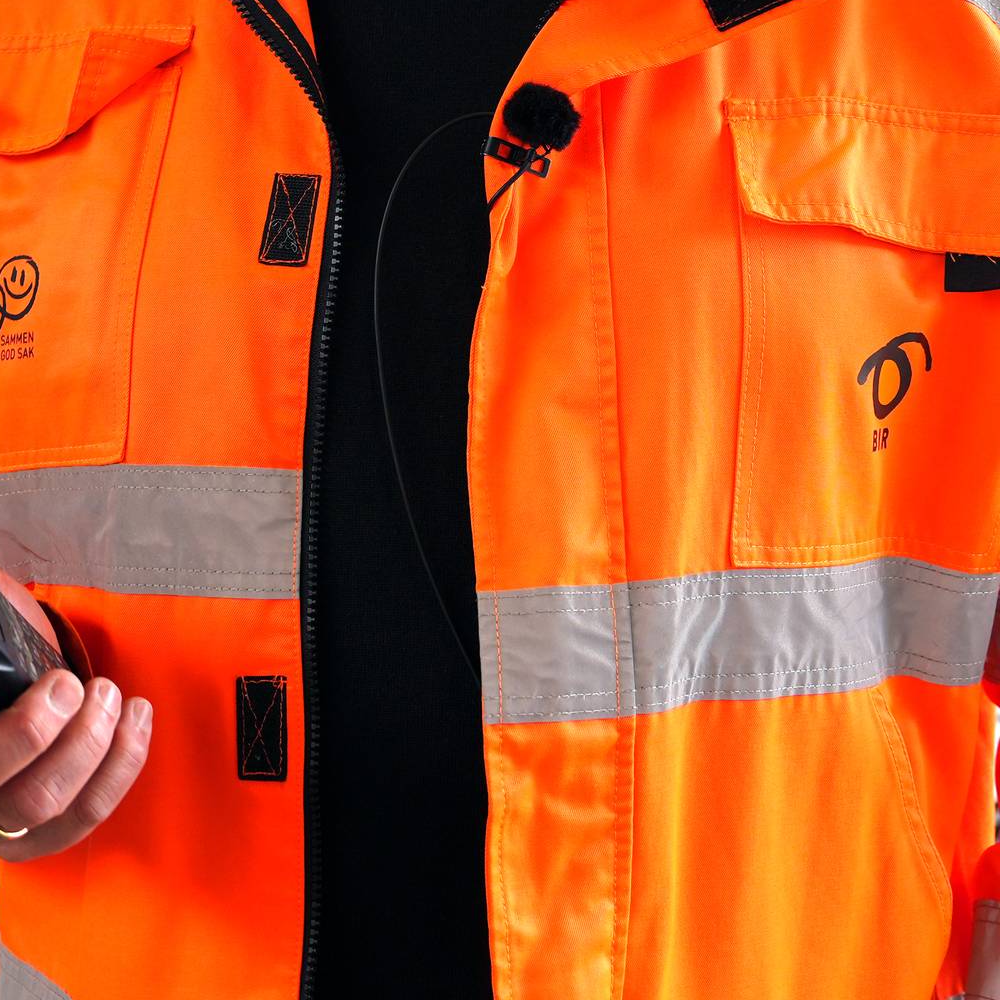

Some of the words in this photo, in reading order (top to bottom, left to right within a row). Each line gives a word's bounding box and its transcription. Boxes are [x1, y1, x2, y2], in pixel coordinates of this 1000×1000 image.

[0, 332, 34, 346] SAMMEN
[0, 349, 16, 361] GOD
[17, 347, 34, 359] SAK
[872, 427, 889, 452] BIR
